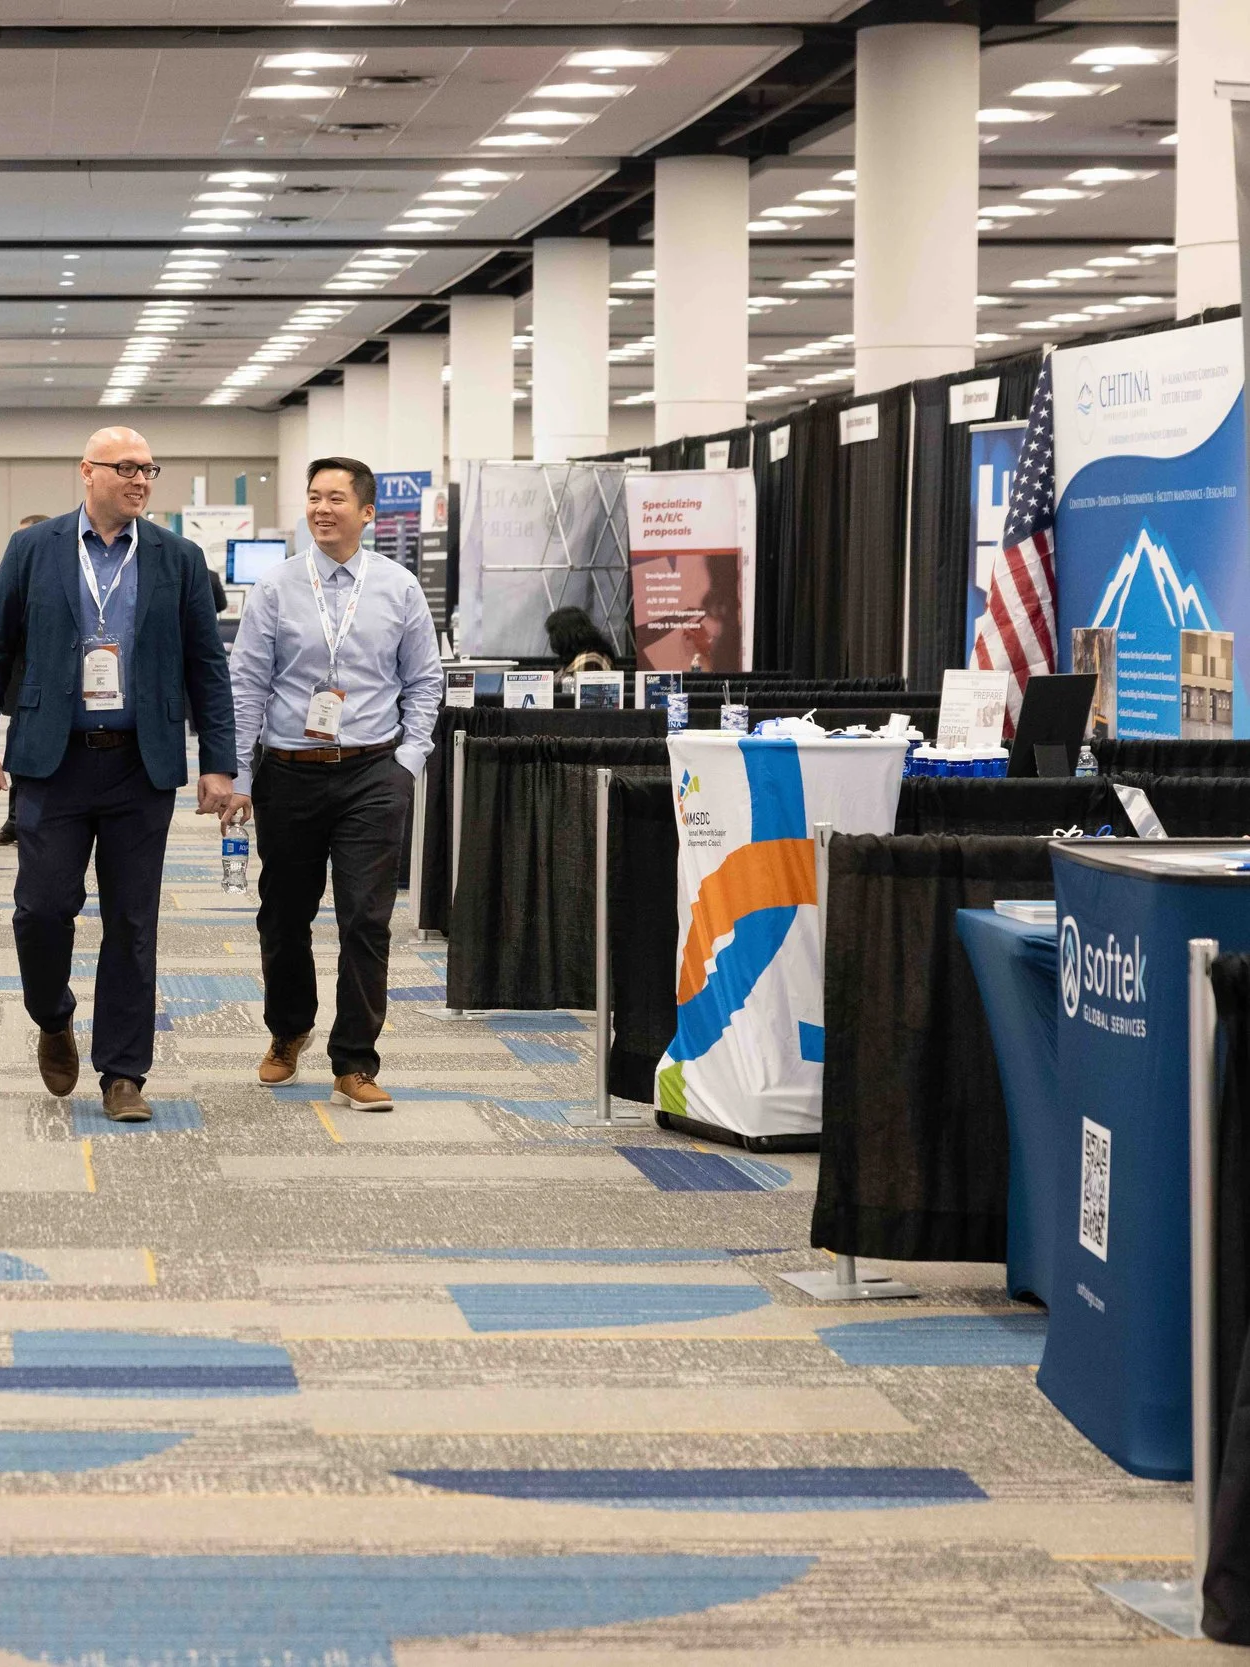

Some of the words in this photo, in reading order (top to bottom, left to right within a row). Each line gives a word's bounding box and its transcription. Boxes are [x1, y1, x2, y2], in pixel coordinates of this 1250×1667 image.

[1099, 371, 1151, 407] CHITINA
[642, 499, 702, 511] Specializing
[643, 514, 652, 522] in
[655, 513, 683, 523] A/E/C
[643, 526, 692, 538] proposals
[973, 691, 1003, 700] PREPARE
[940, 726, 969, 735] CONTACT
[1083, 933, 1147, 1003] softek
[1083, 1004, 1109, 1031] GLOBAL
[1111, 1015, 1147, 1037] SERVICES
